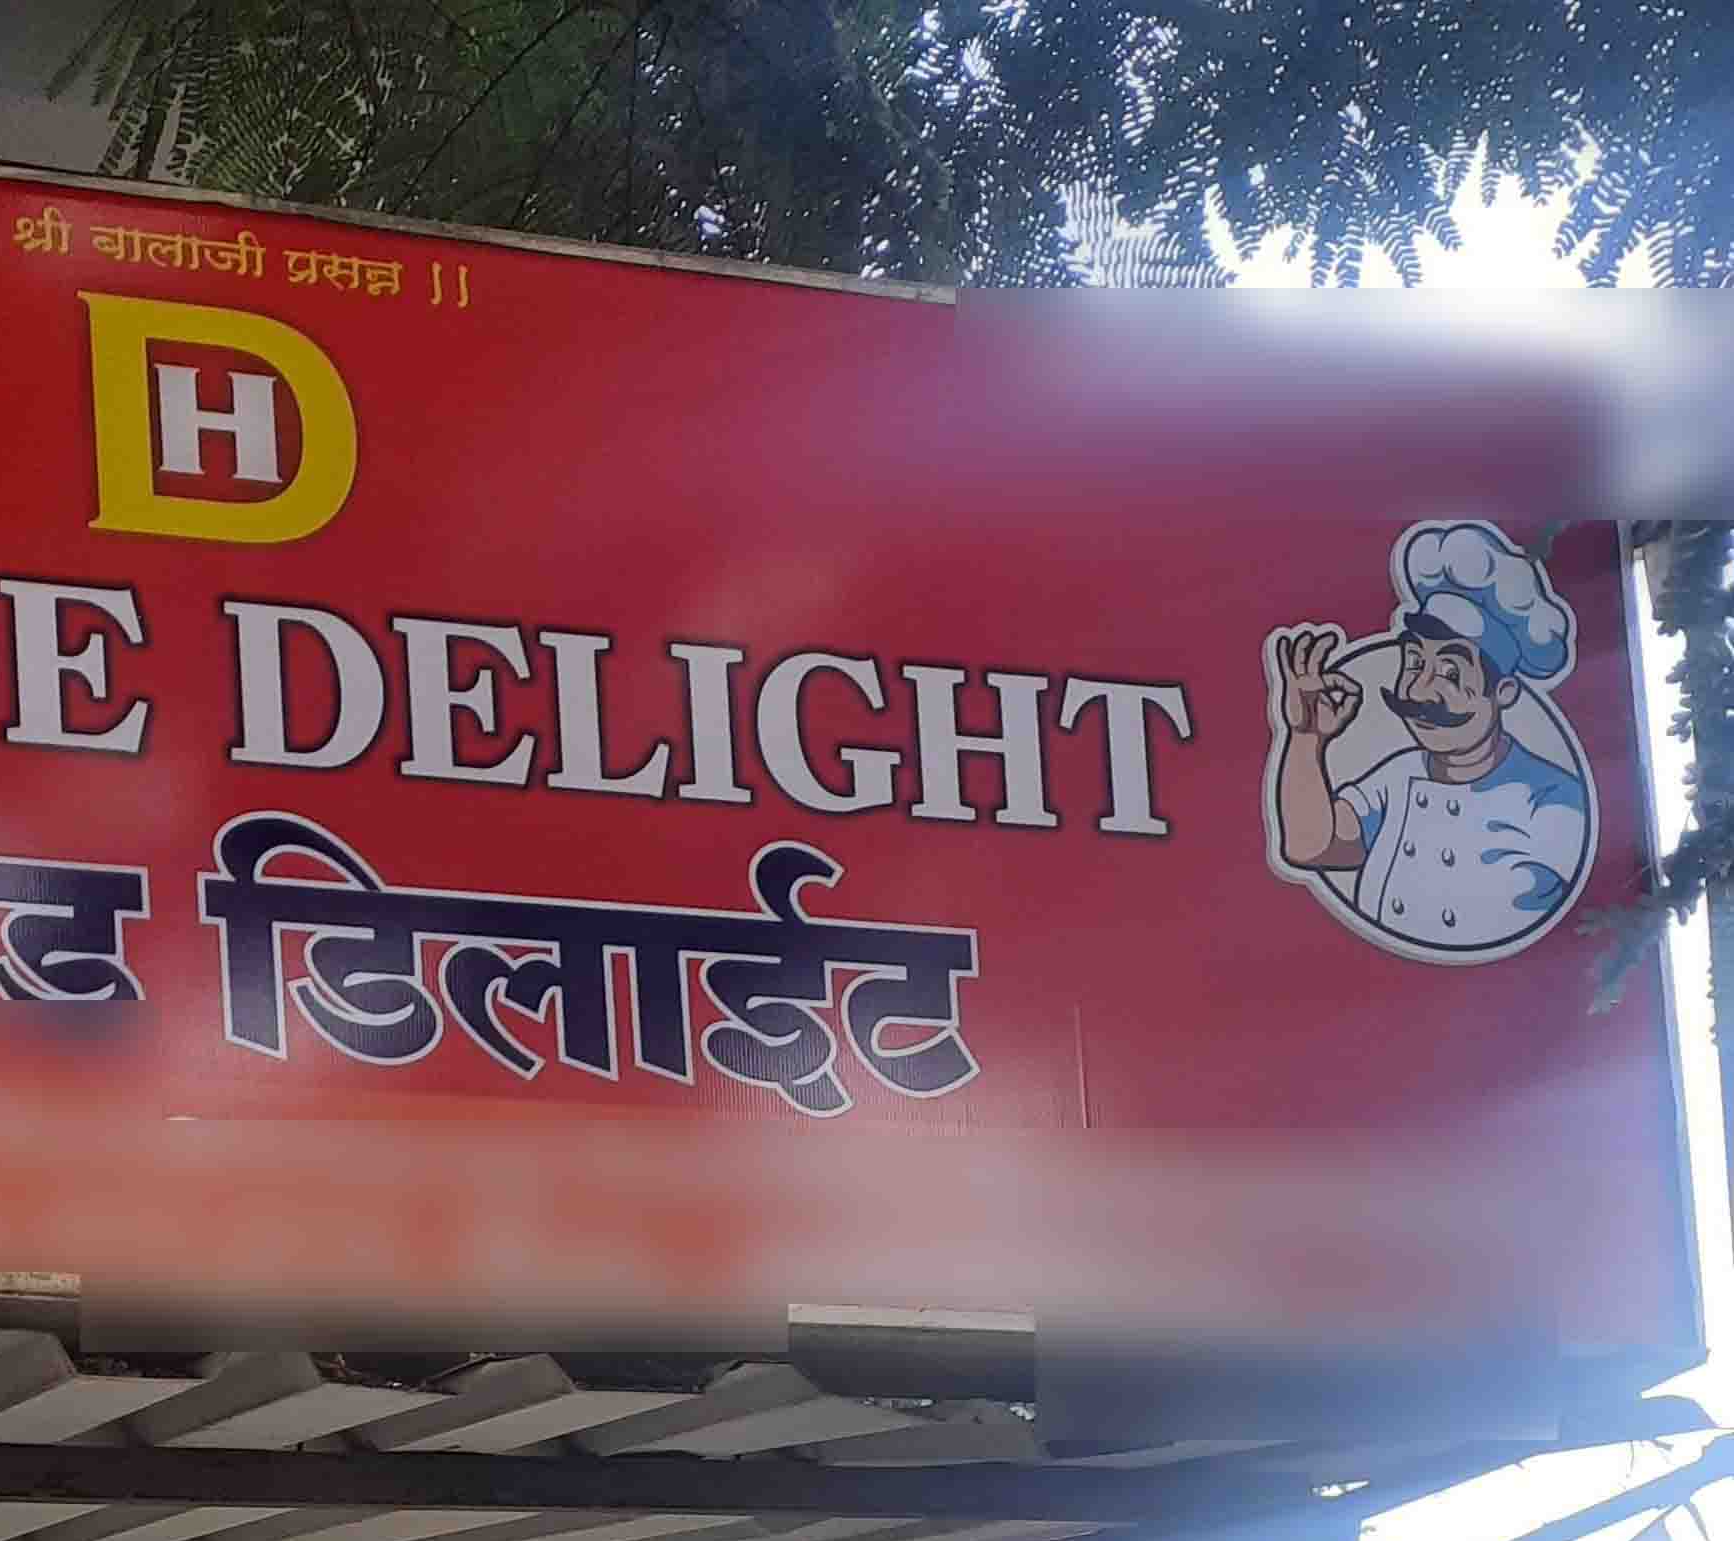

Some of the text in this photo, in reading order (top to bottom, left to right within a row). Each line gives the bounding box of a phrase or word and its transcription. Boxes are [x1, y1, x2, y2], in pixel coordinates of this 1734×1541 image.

[13, 206, 74, 256] श्री
[89, 222, 268, 280] बालाजी
[282, 247, 404, 298] प्रसन्न
[222, 599, 1192, 837] DELIGHT
[196, 807, 984, 1120] डिलाईट
